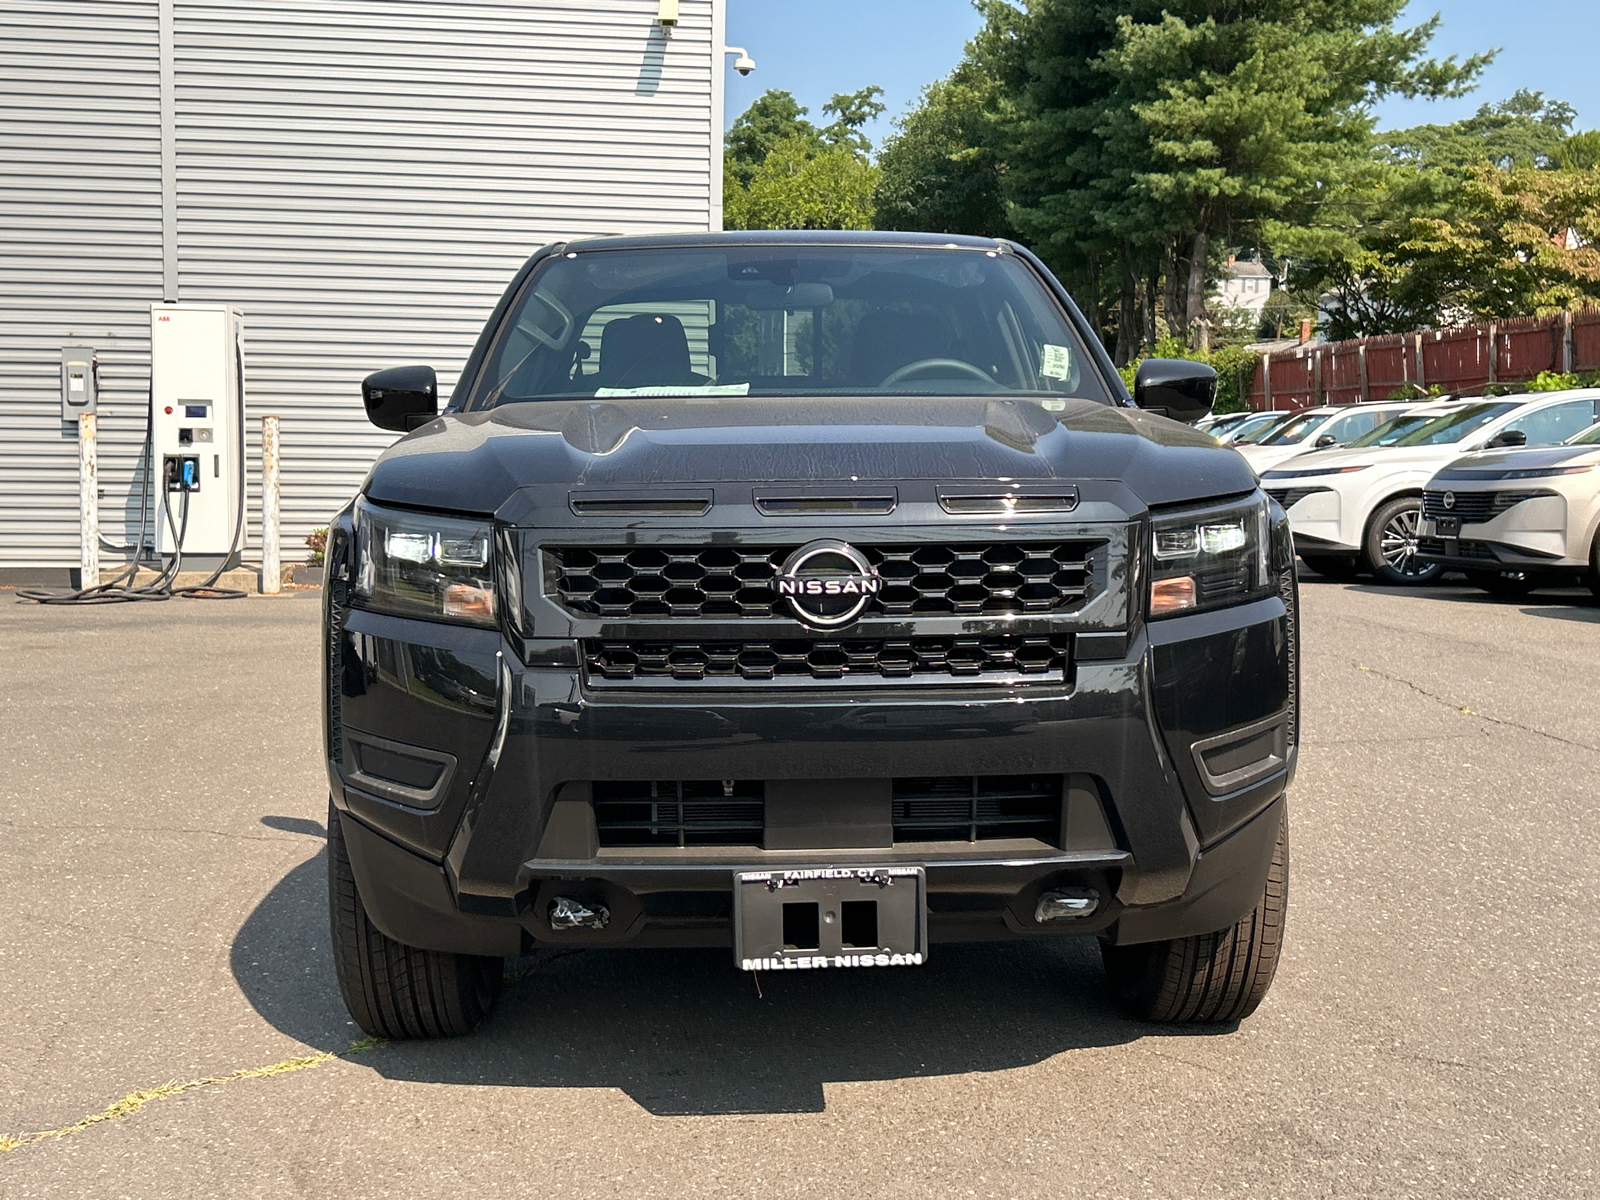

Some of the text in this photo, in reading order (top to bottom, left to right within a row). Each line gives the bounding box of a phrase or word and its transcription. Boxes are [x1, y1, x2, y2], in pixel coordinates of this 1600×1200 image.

[780, 579, 877, 594] NISSAN
[784, 868, 876, 879] FAIRFIELD, CT
[887, 868, 918, 876] NISSAN
[742, 952, 923, 971] MILLER NISSAN
